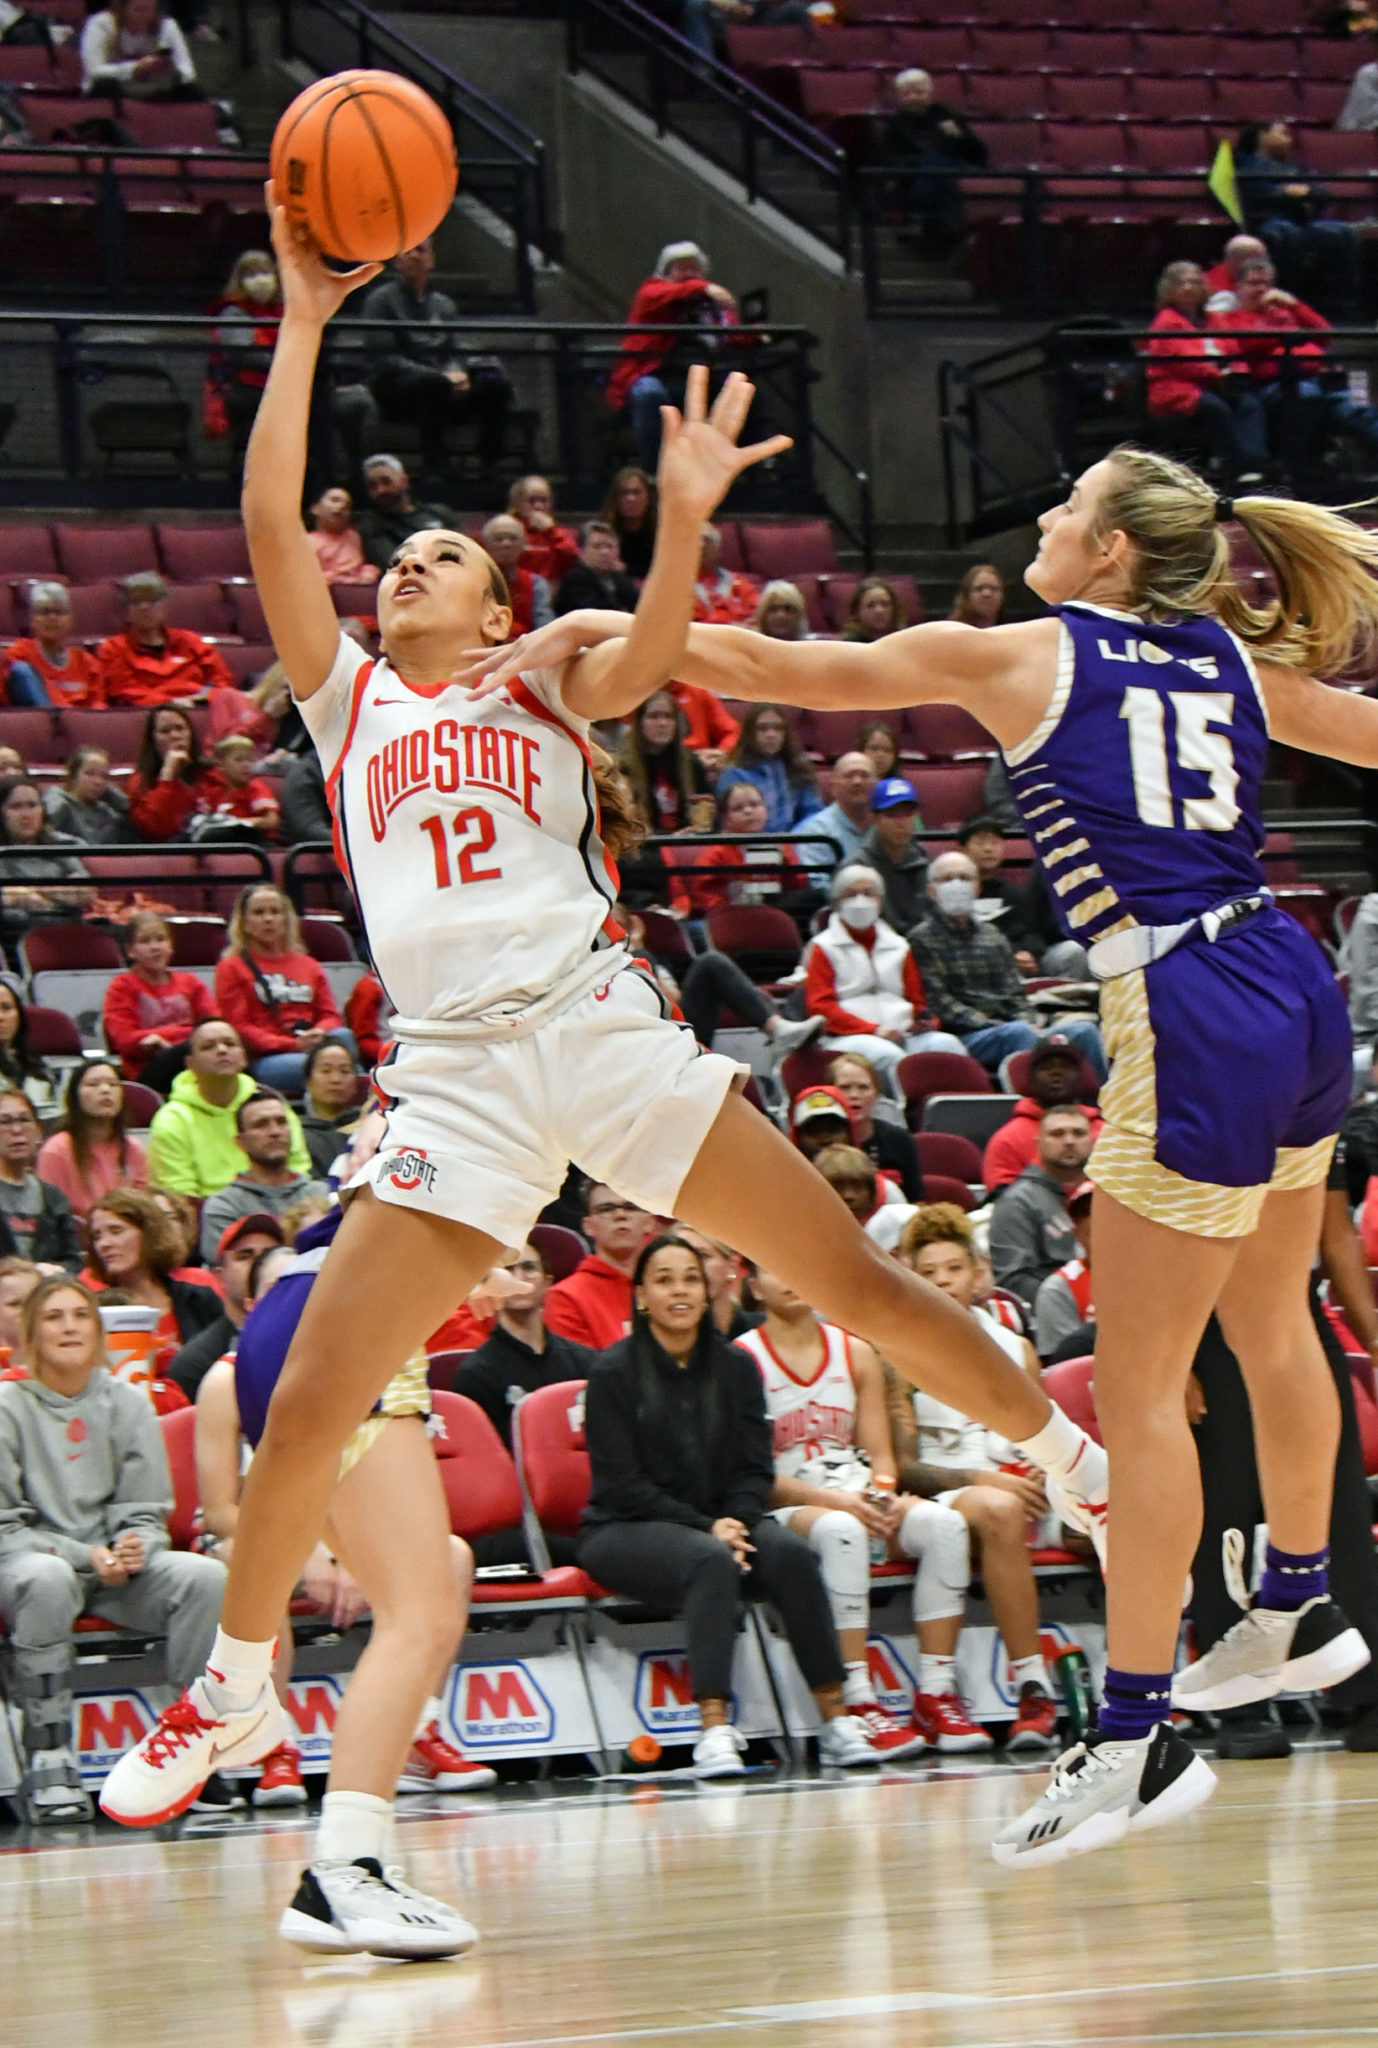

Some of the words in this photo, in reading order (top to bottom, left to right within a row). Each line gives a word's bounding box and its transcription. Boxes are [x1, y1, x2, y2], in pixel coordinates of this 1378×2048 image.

[1097, 638, 1220, 680] LIOS
[366, 728, 430, 844] OHIO
[433, 718, 542, 827] STATE
[1118, 686, 1243, 832] 15
[419, 806, 503, 890] 12
[403, 1154, 438, 1194] STATE
[465, 1671, 539, 1721] M
[78, 1700, 147, 1752] M
[466, 1721, 545, 1736] Marathon
